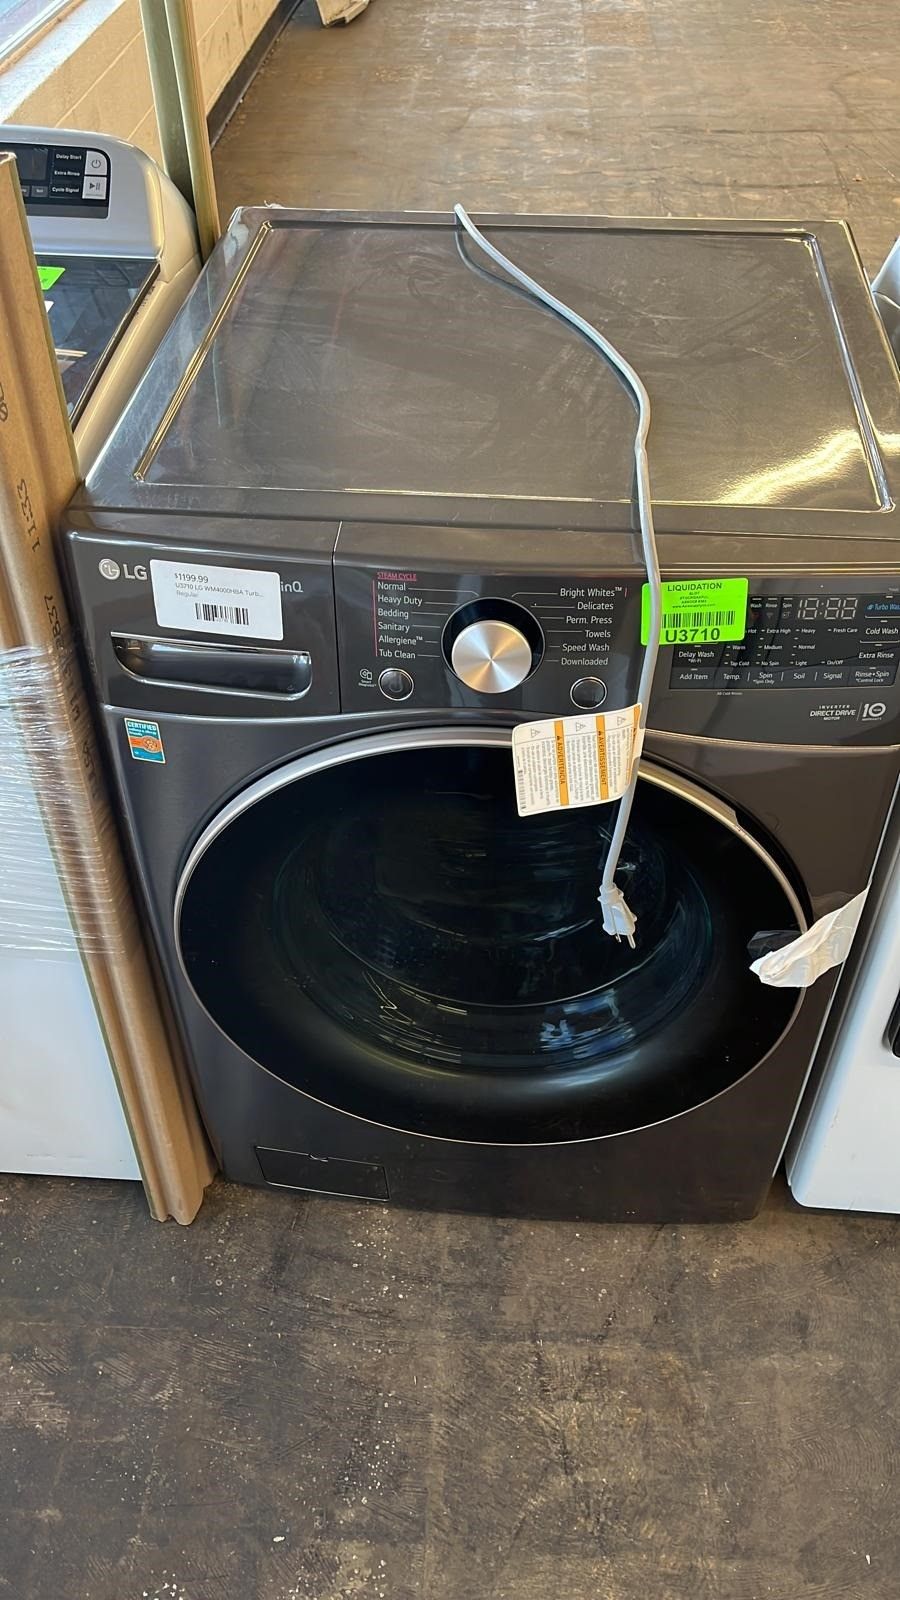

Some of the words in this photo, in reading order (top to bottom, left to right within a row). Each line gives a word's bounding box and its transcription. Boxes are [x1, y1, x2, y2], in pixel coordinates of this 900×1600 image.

[124, 564, 147, 580] LG
[175, 572, 209, 584] $1199.99
[175, 582, 194, 590] U3710
[280, 580, 304, 593] inQ
[377, 581, 406, 591] Normal
[667, 582, 722, 592] LIQUIDATION
[560, 587, 585, 599] Bright
[377, 594, 402, 606] Heavy
[403, 596, 423, 606] Duty
[577, 601, 614, 610] Delicates
[377, 608, 409, 620] Bedding
[566, 615, 588, 624] Perm.
[590, 615, 613, 624] Press
[378, 622, 410, 633] Sanitary
[865, 627, 881, 635] Cold
[585, 629, 611, 638] Towels
[665, 628, 720, 643] U3710
[562, 643, 587, 653] Speed
[588, 643, 610, 652] Wash
[379, 649, 393, 658] Tub
[394, 650, 416, 659] Clean
[678, 651, 697, 659] Delay
[561, 657, 609, 666] Downloaded
[759, 672, 773, 680] Spin
[823, 673, 843, 681] Signal
[862, 702, 887, 718] 10
